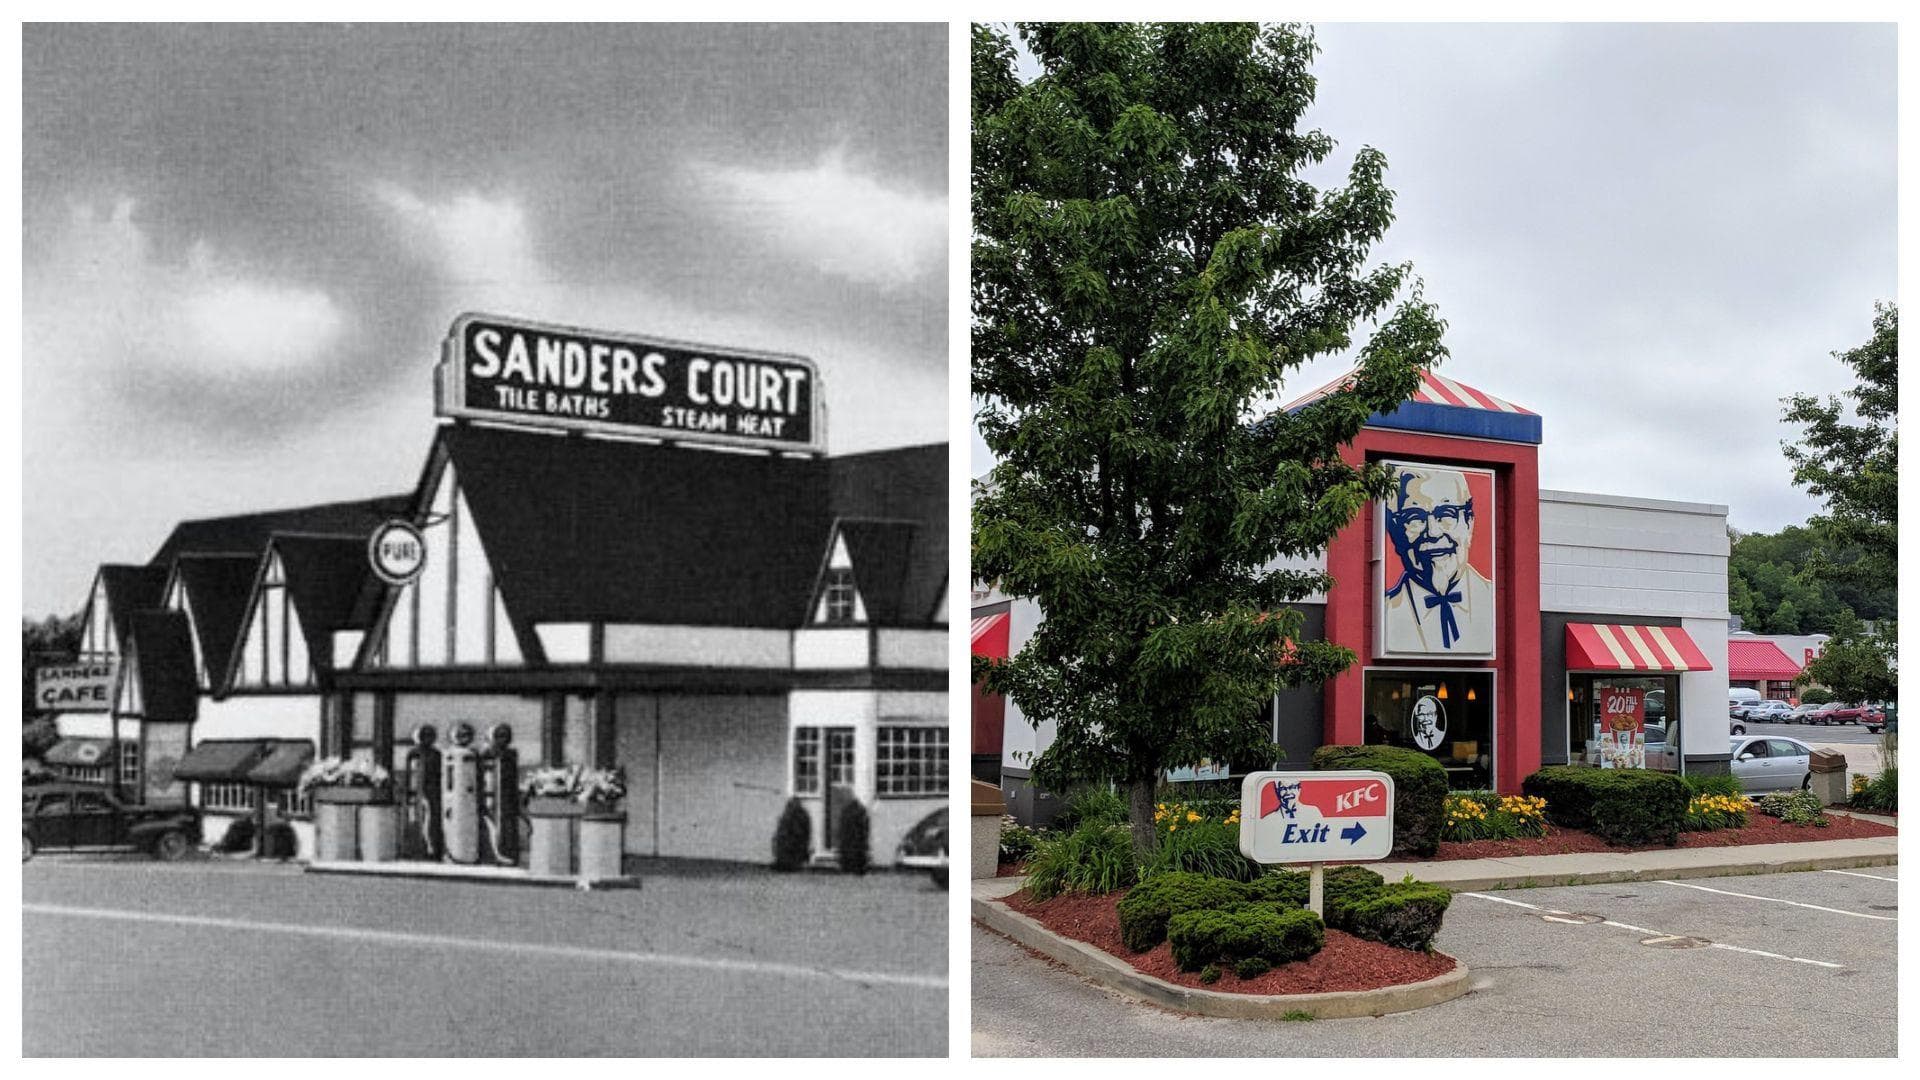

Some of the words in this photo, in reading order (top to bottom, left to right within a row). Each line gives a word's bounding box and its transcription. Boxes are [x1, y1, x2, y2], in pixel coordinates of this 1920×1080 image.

[472, 328, 666, 397] SANDERS
[687, 358, 806, 415] COURT
[495, 385, 539, 411] TILE
[545, 391, 610, 418] BATHS
[662, 406, 727, 432] STEAM
[736, 412, 786, 437] HEAT
[42, 685, 107, 703] CAFE
[1626, 695, 1638, 705] FILL
[1626, 704, 1635, 713] UP
[1335, 783, 1380, 813] KFC
[1282, 822, 1330, 844] Exit
